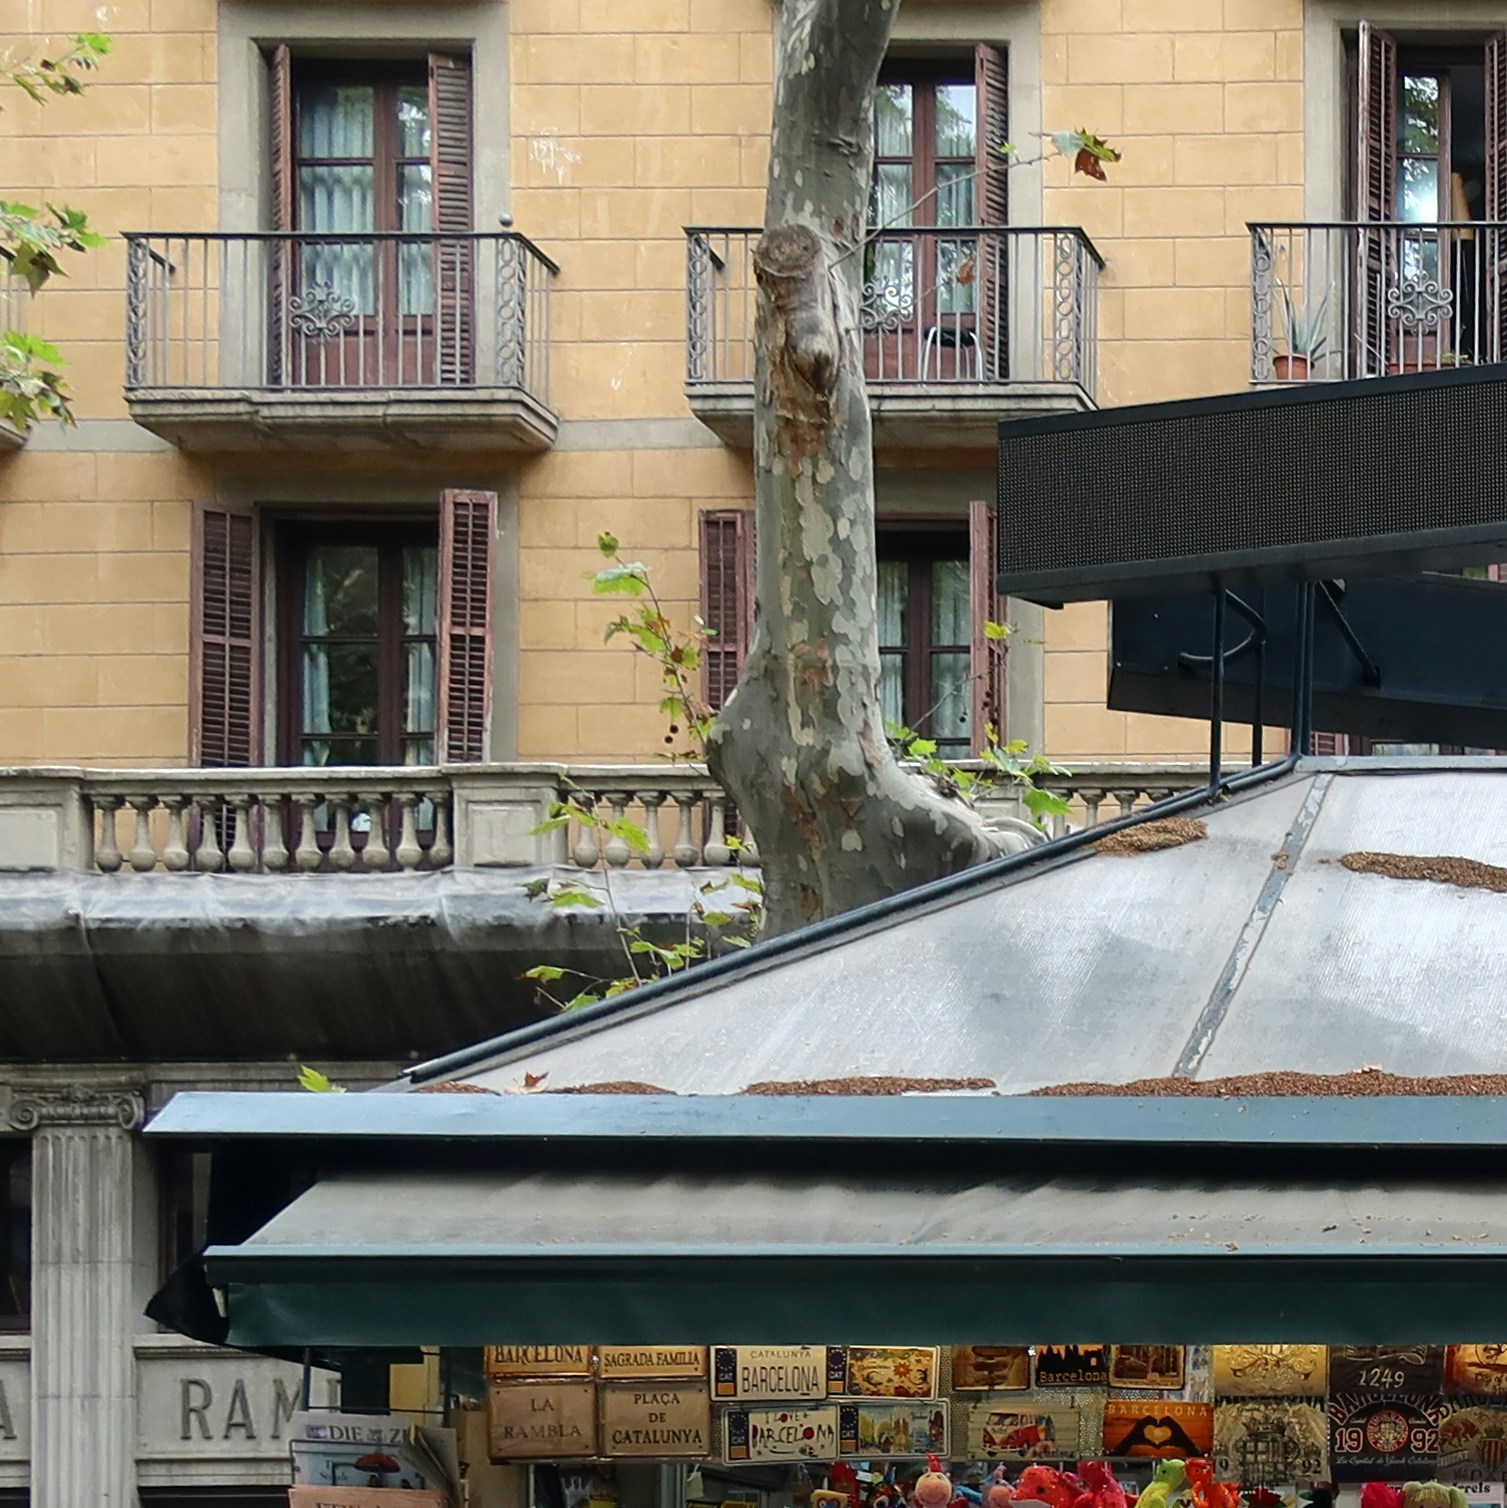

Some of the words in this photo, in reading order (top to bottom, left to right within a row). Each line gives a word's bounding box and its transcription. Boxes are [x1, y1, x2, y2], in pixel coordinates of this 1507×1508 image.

[604, 1352, 655, 1367] SAGRADA
[655, 1352, 700, 1367] FAMILIA
[742, 1365, 820, 1393] BARCELONA
[1358, 1370, 1406, 1388] 1249
[531, 1399, 555, 1412] LA
[634, 1393, 681, 1407] PLAÇA
[649, 1413, 667, 1424] DE
[329, 1425, 362, 1441] DIE
[504, 1425, 583, 1440] RAMBLA
[612, 1429, 703, 1446] CATALUNYA
[1334, 1428, 1363, 1453] 19
